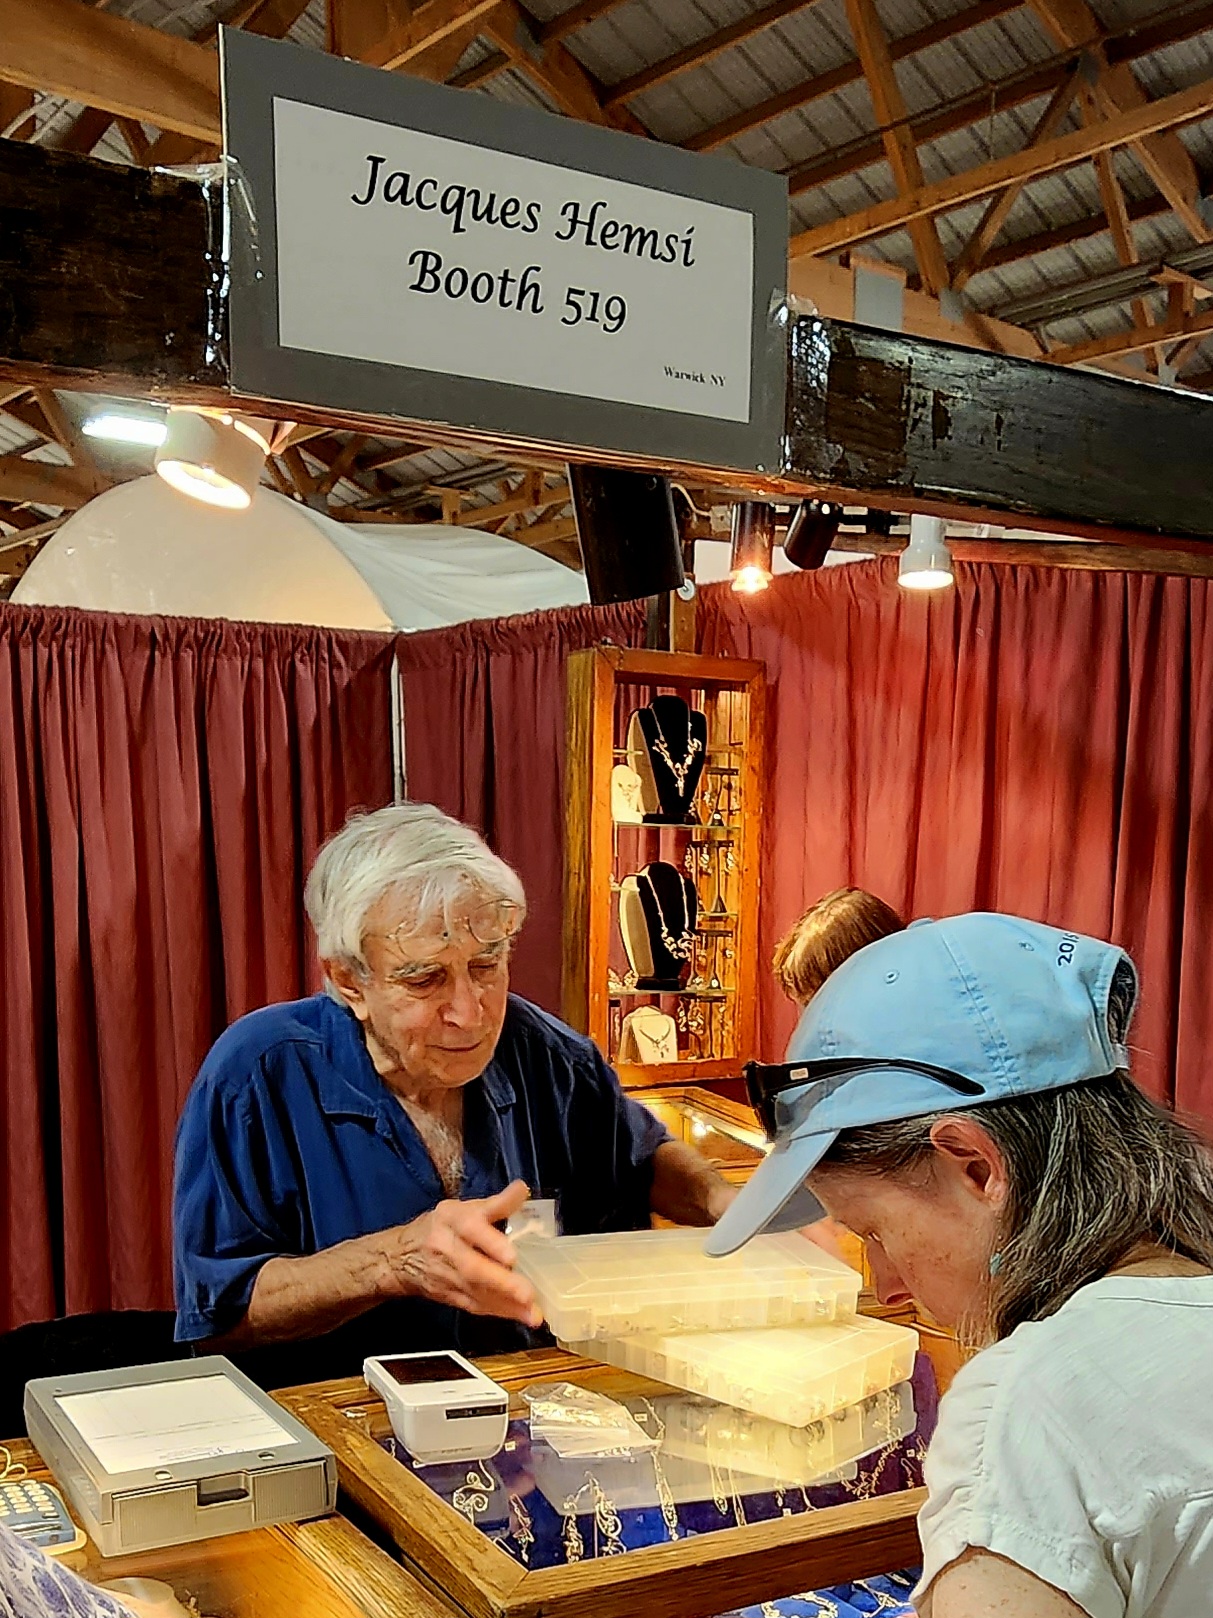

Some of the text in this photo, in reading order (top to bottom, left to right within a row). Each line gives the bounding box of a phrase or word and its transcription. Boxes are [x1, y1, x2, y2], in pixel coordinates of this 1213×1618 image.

[351, 154, 696, 268] Jacques Hemsi
[408, 250, 627, 334] Booth 519
[663, 365, 727, 387] Warwick NY
